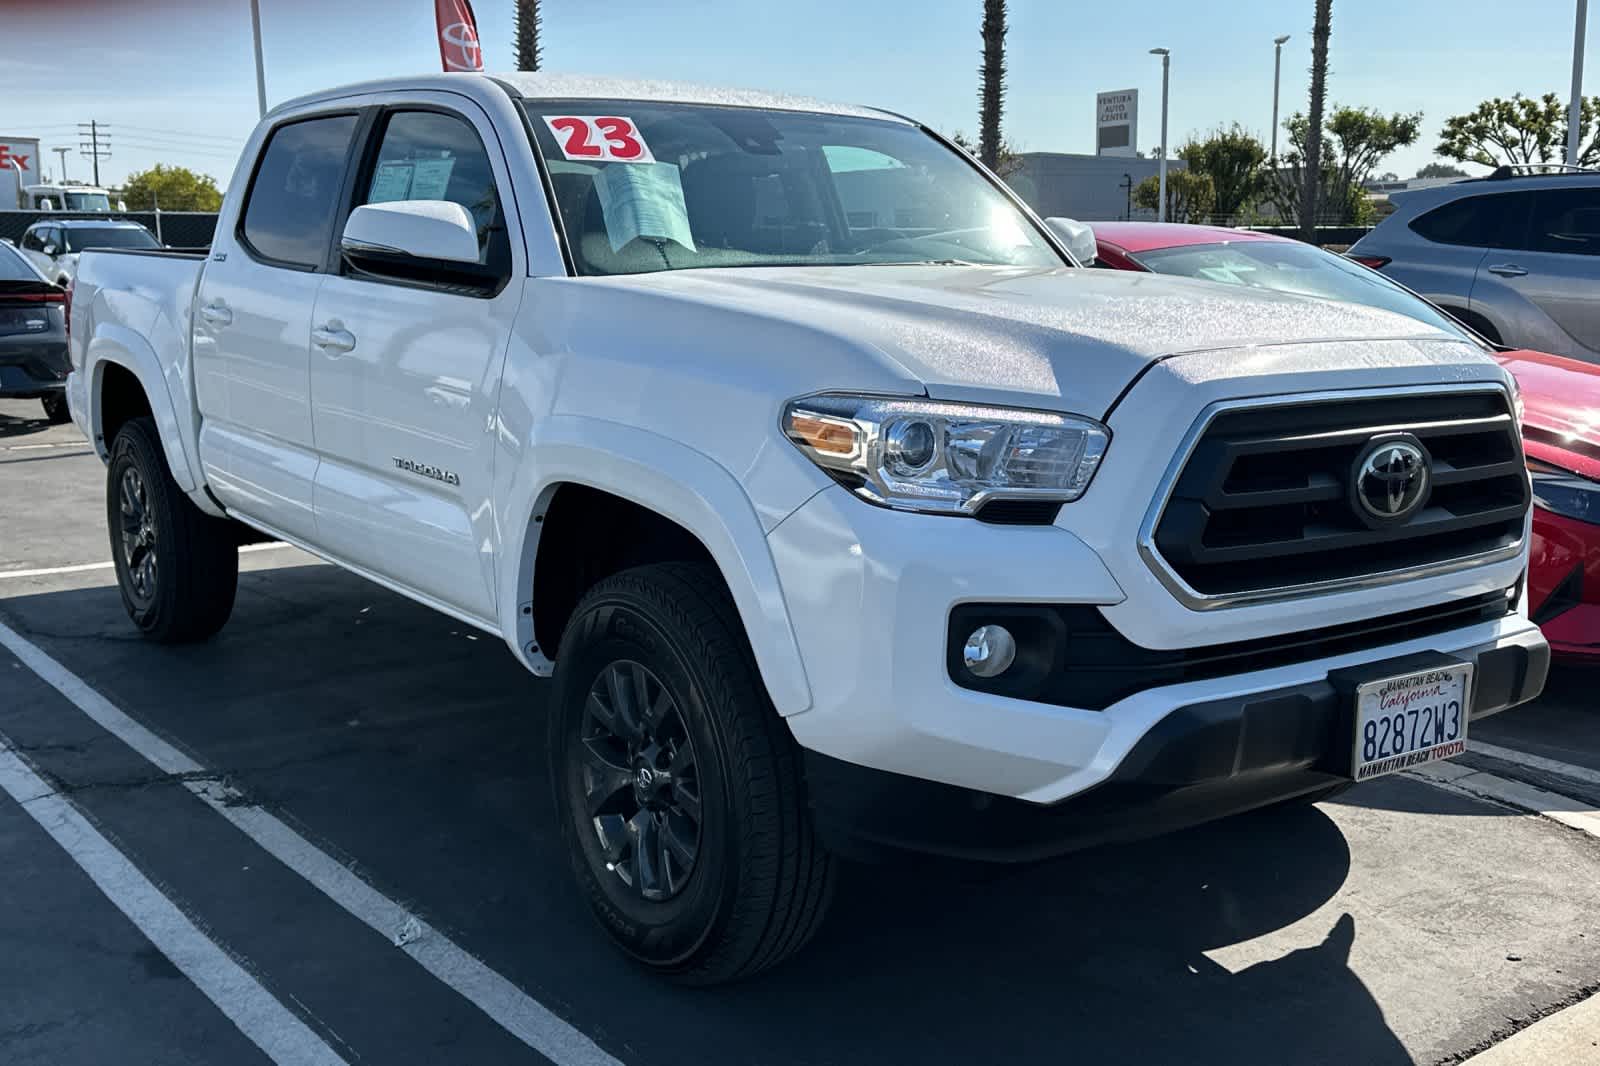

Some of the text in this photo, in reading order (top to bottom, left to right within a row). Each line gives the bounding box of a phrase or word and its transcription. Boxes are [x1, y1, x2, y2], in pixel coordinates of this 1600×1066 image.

[1098, 95, 1132, 105] VENTURA
[1105, 104, 1125, 113] AUTO
[1100, 112, 1129, 121] CENTER
[551, 117, 642, 159] 23
[392, 456, 460, 486] TACOMA
[1387, 671, 1449, 691] MANHATTAN BEACH
[1380, 685, 1447, 711] California
[1364, 700, 1459, 761] 82872W3
[1358, 741, 1465, 779] MANHATTAN BEACH TOYOTA
